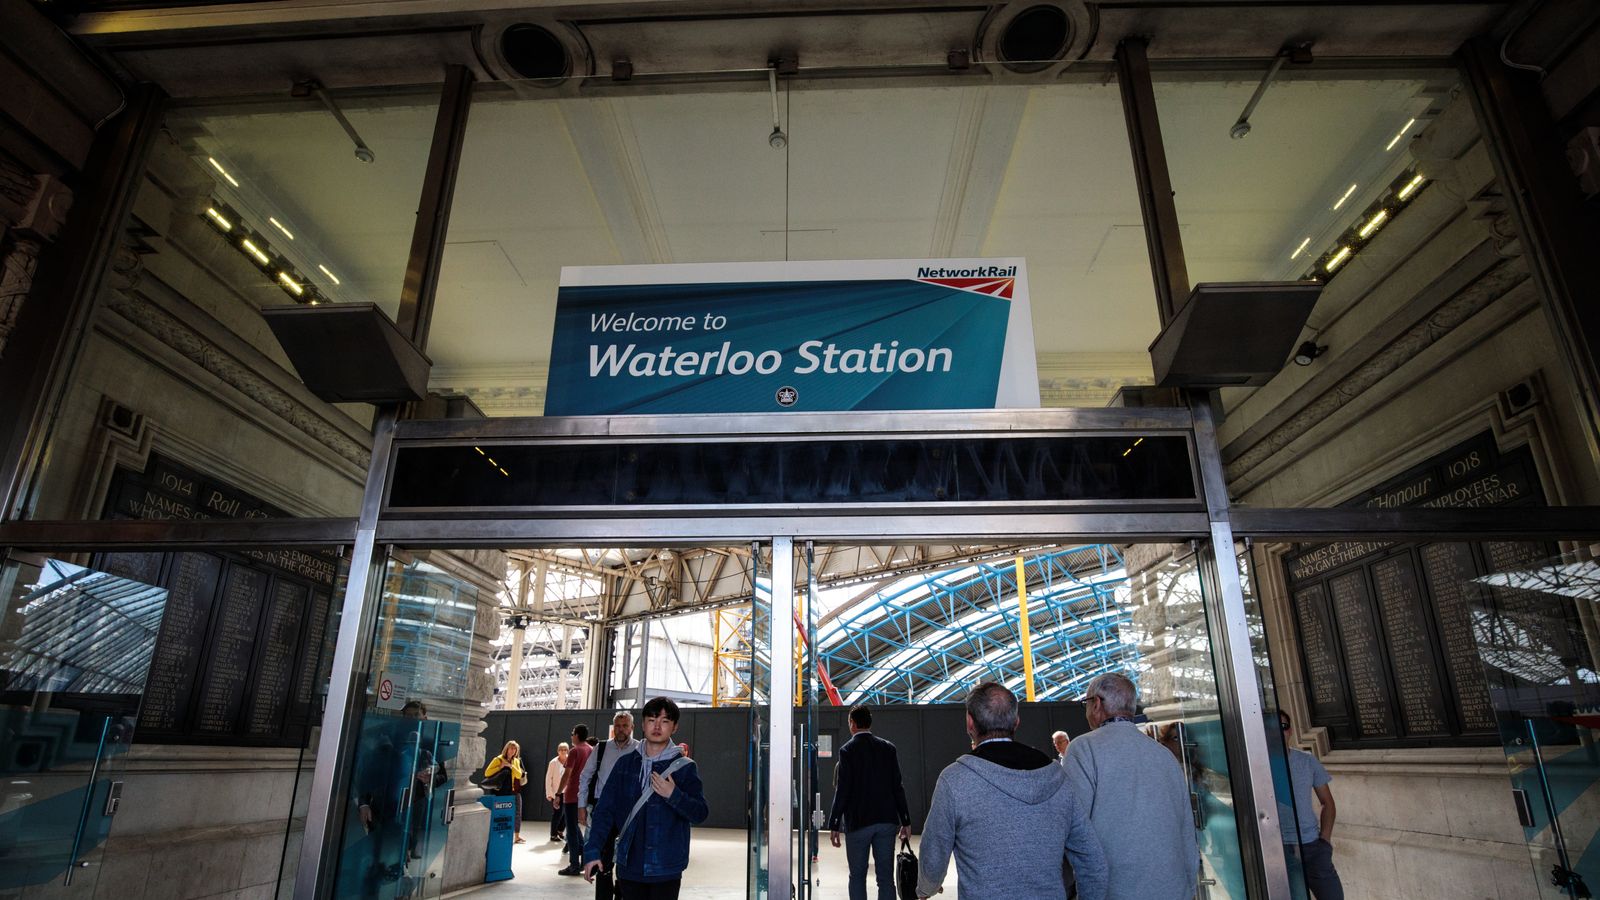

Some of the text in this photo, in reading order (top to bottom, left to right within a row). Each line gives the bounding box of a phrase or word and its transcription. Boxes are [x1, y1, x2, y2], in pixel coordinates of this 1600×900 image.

[591, 312, 727, 333] Welcome to
[589, 340, 953, 378] Waterloo Station
[207, 490, 240, 518] Roll
[279, 556, 297, 573] THE
[1294, 564, 1314, 579] WHO
[1315, 554, 1338, 573] GAVE
[1339, 545, 1366, 564] THEIR
[1299, 547, 1328, 568] NAMES
